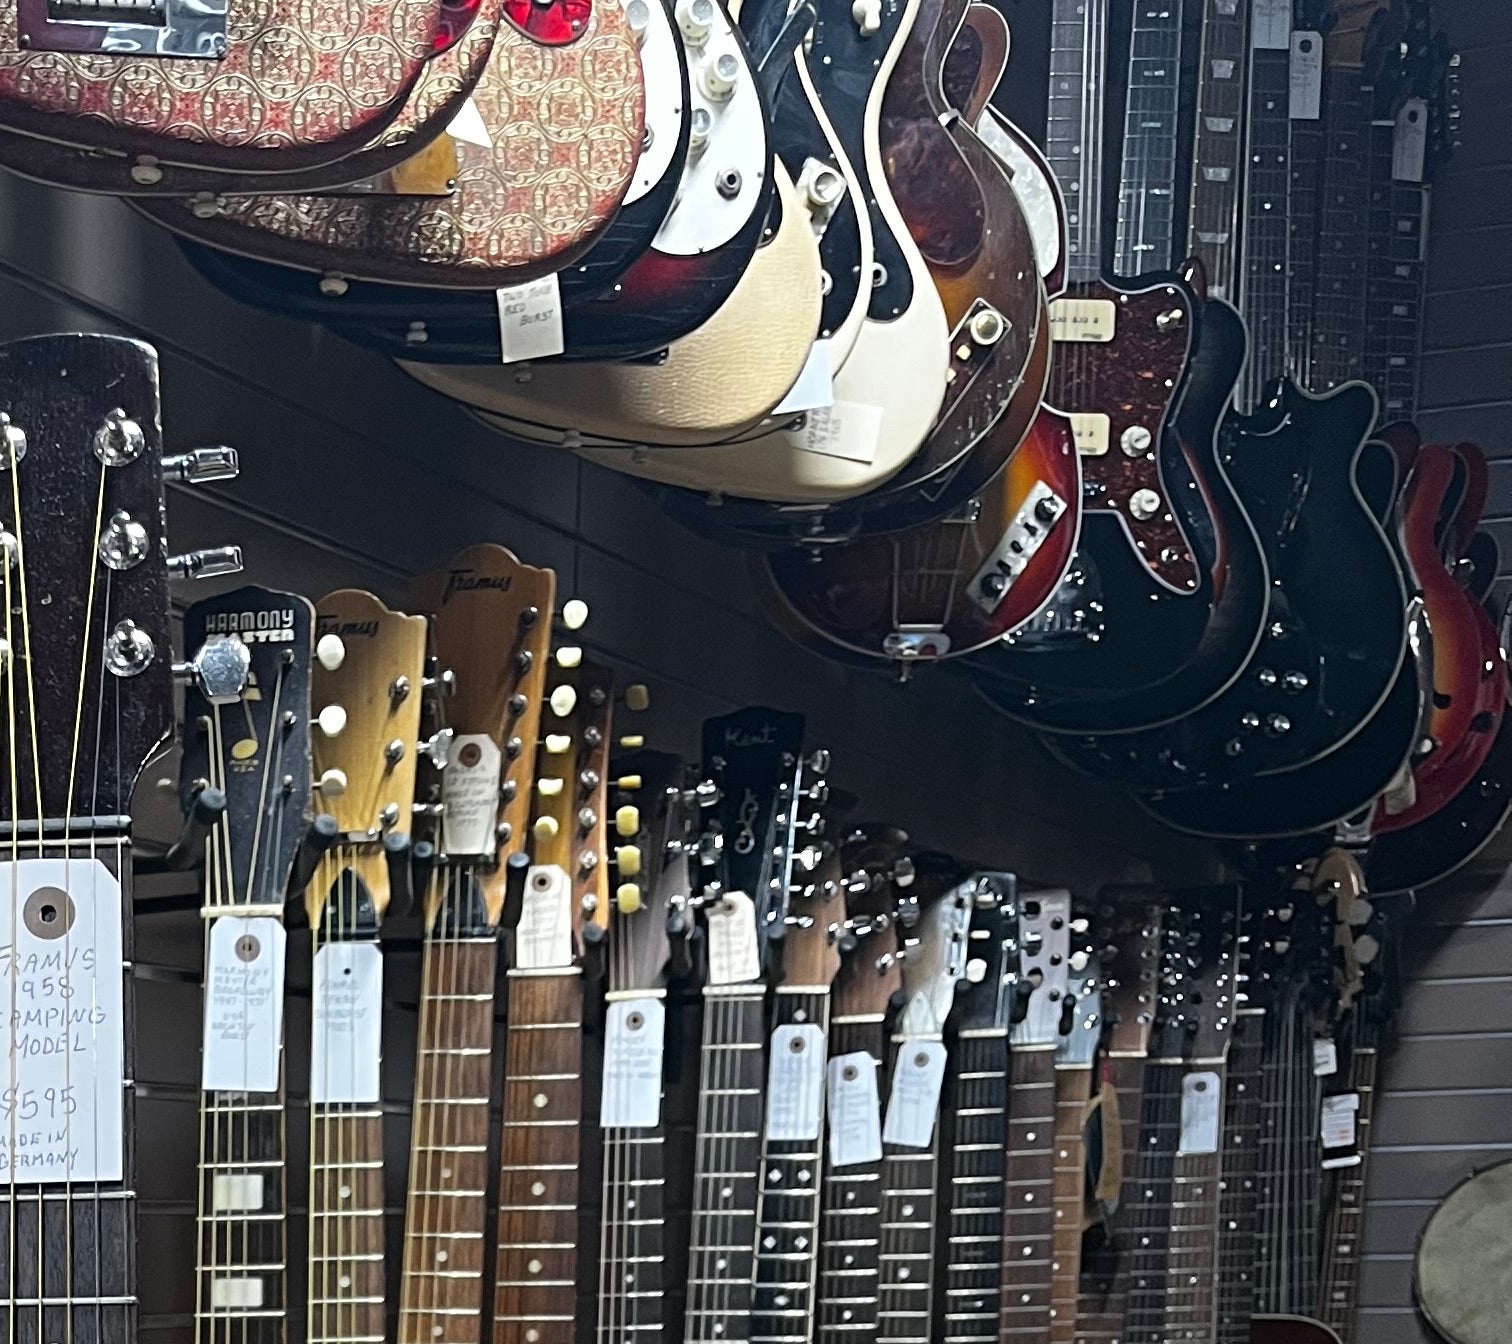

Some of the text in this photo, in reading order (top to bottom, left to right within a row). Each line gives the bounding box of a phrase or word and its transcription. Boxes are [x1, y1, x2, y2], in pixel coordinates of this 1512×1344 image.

[504, 303, 527, 316] RED
[520, 309, 554, 327] BURST
[443, 569, 512, 605] Framus
[205, 609, 295, 632] HARMONY
[13, 976, 74, 1000] 958
[9, 1032, 87, 1059] MODEL
[0, 1081, 77, 1120] $595
[47, 1123, 69, 1144] IN
